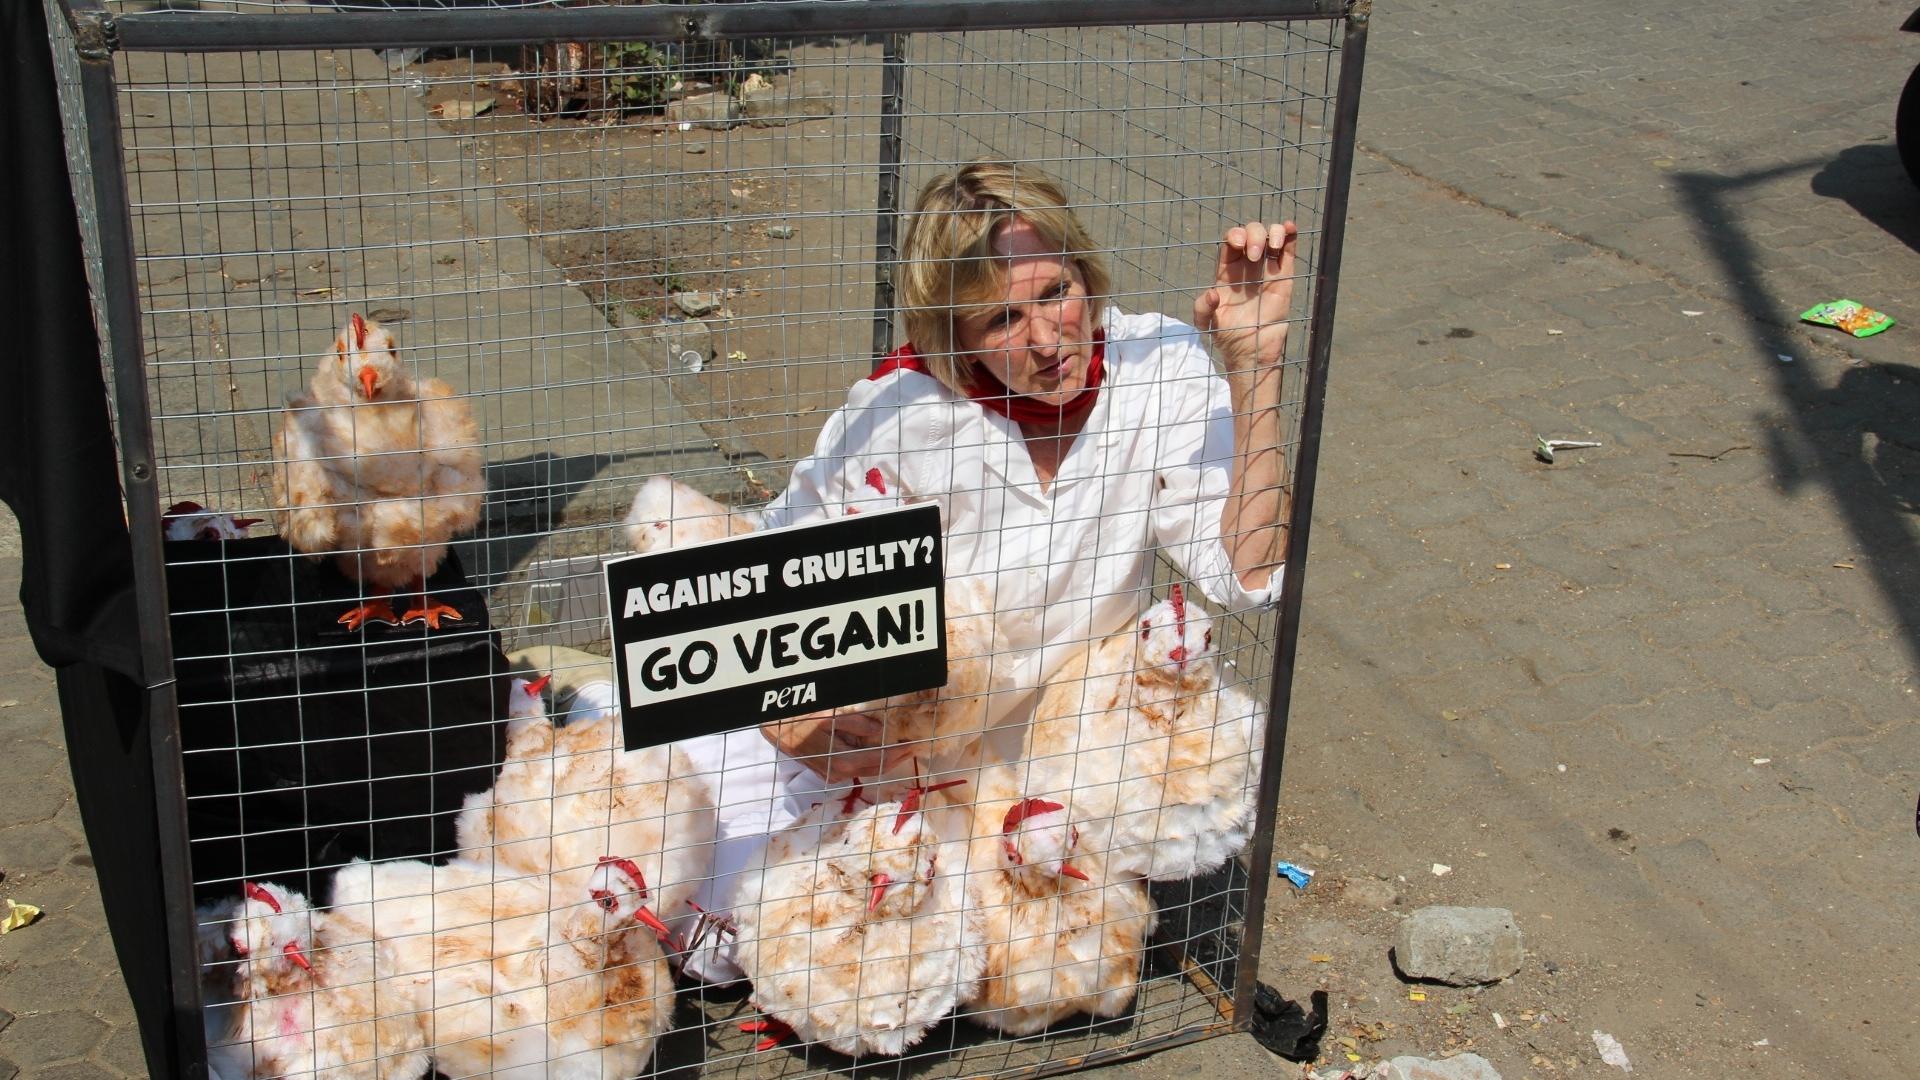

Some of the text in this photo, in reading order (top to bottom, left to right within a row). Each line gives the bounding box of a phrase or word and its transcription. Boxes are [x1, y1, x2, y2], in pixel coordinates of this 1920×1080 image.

[624, 535, 934, 619] AGAINST CRUELTY?
[641, 599, 925, 692] GO VEGAN!
